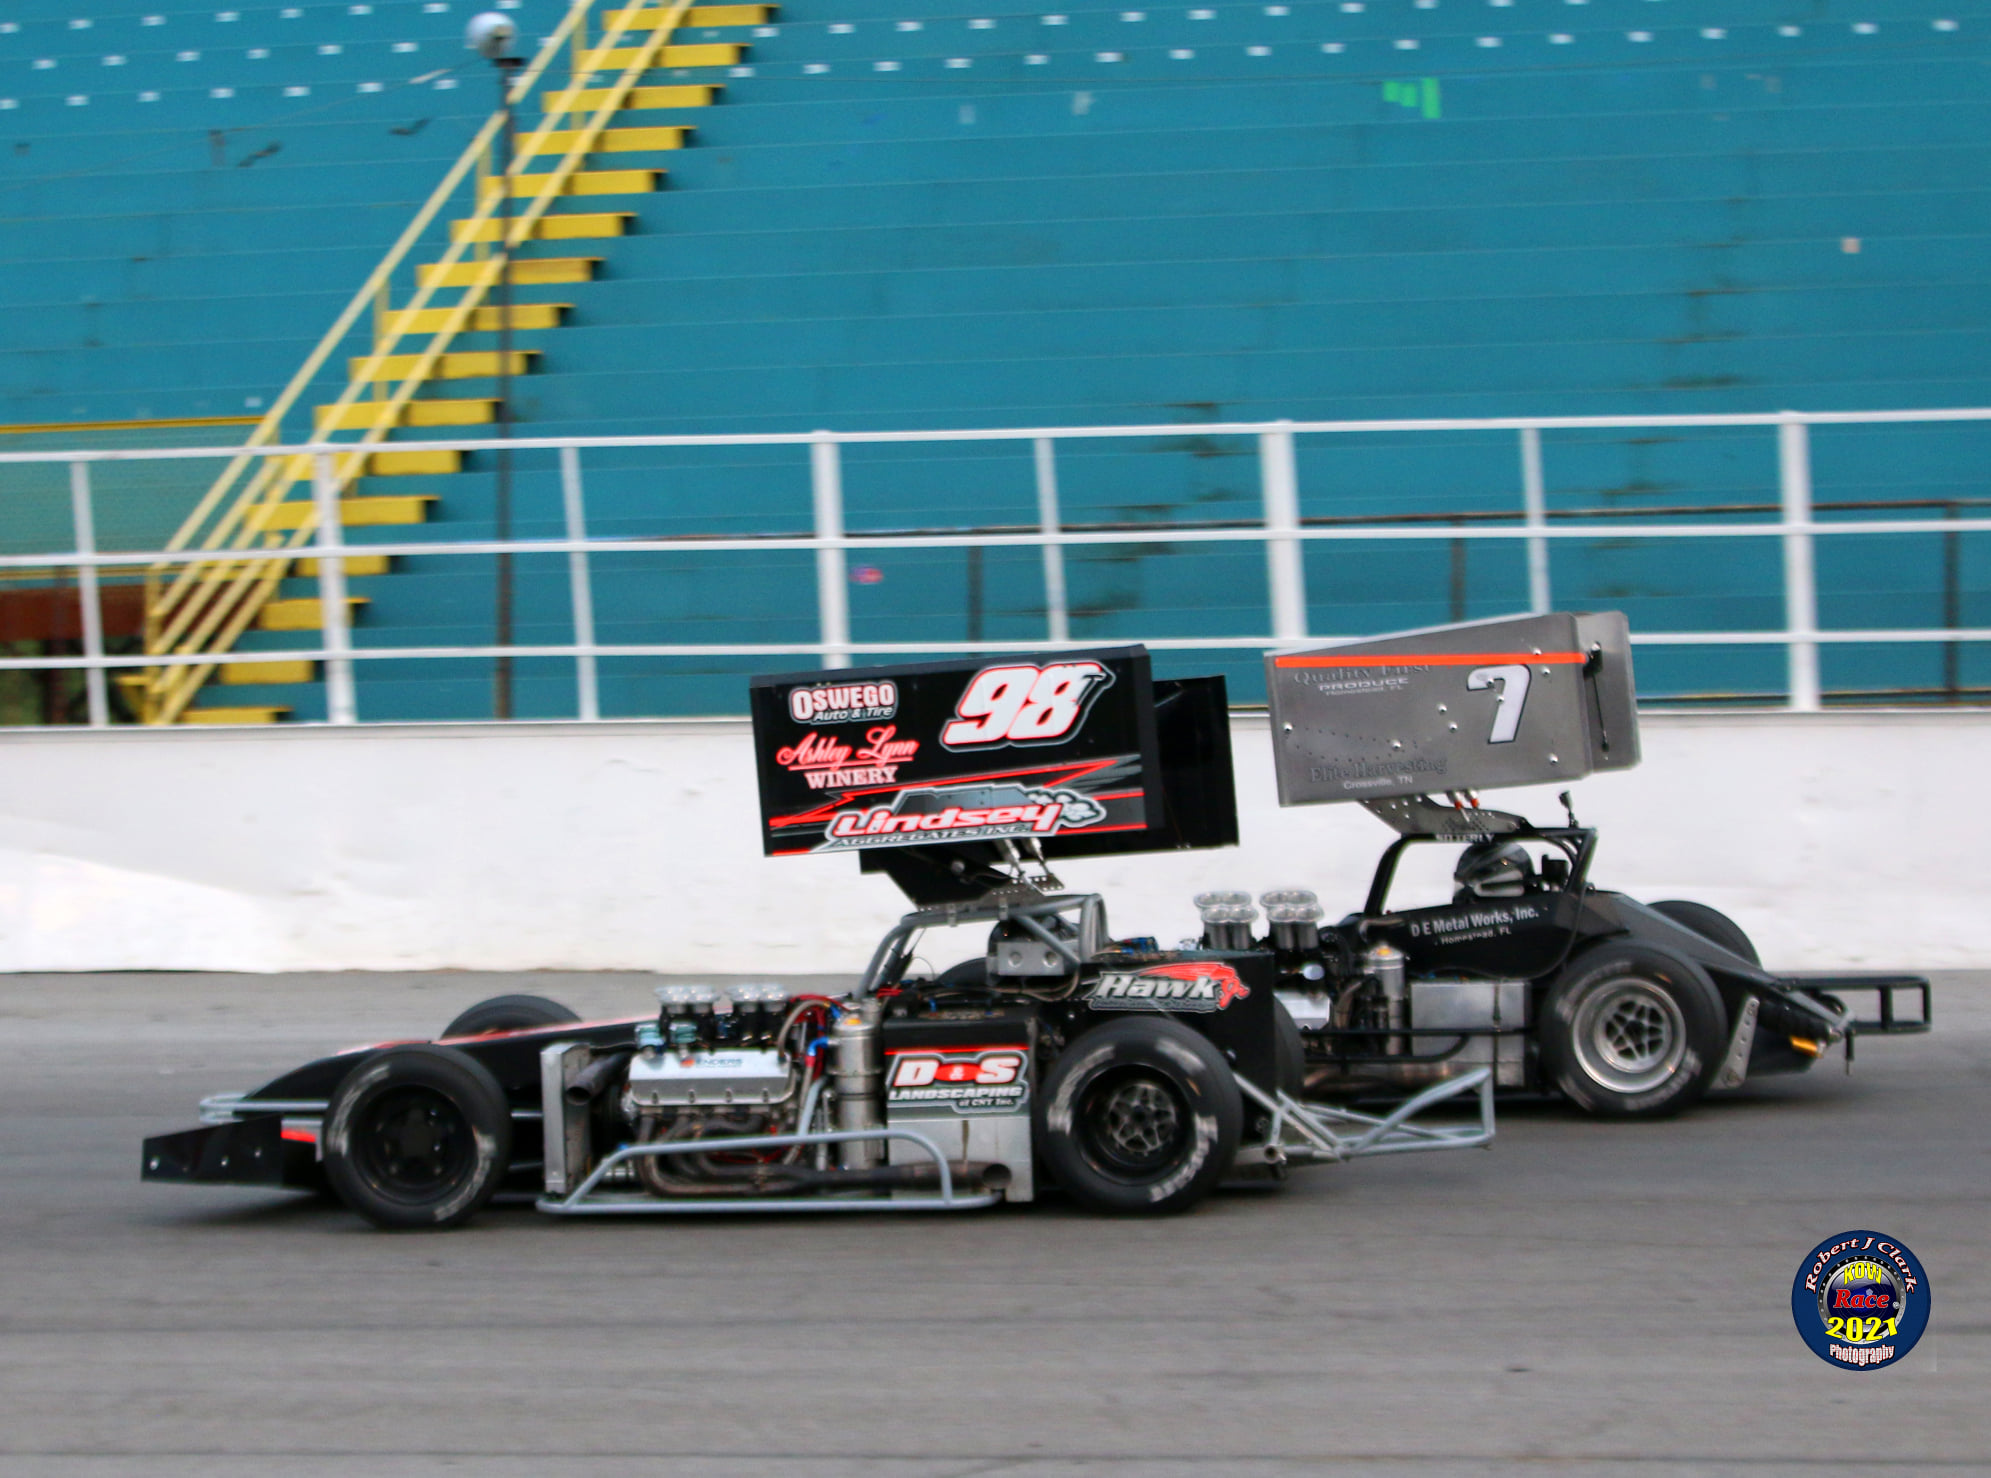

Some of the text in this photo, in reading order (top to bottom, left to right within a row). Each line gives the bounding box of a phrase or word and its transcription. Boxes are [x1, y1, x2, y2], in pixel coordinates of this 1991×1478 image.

[792, 683, 895, 720] OSWEGO
[814, 706, 893, 722] Auto & Tire
[943, 662, 1107, 746] 98
[1466, 664, 1532, 744] 7
[776, 724, 920, 771] Ashley Lynn
[804, 765, 898, 790] WINERY
[833, 803, 1063, 839] Lindsey
[1410, 924, 1420, 937] D
[1423, 922, 1431, 935] E
[1434, 916, 1469, 934] Metal
[1515, 905, 1539, 920] Inc.
[1095, 974, 1220, 999] Hawk
[889, 1086, 1023, 1101] LANDSCAPING
